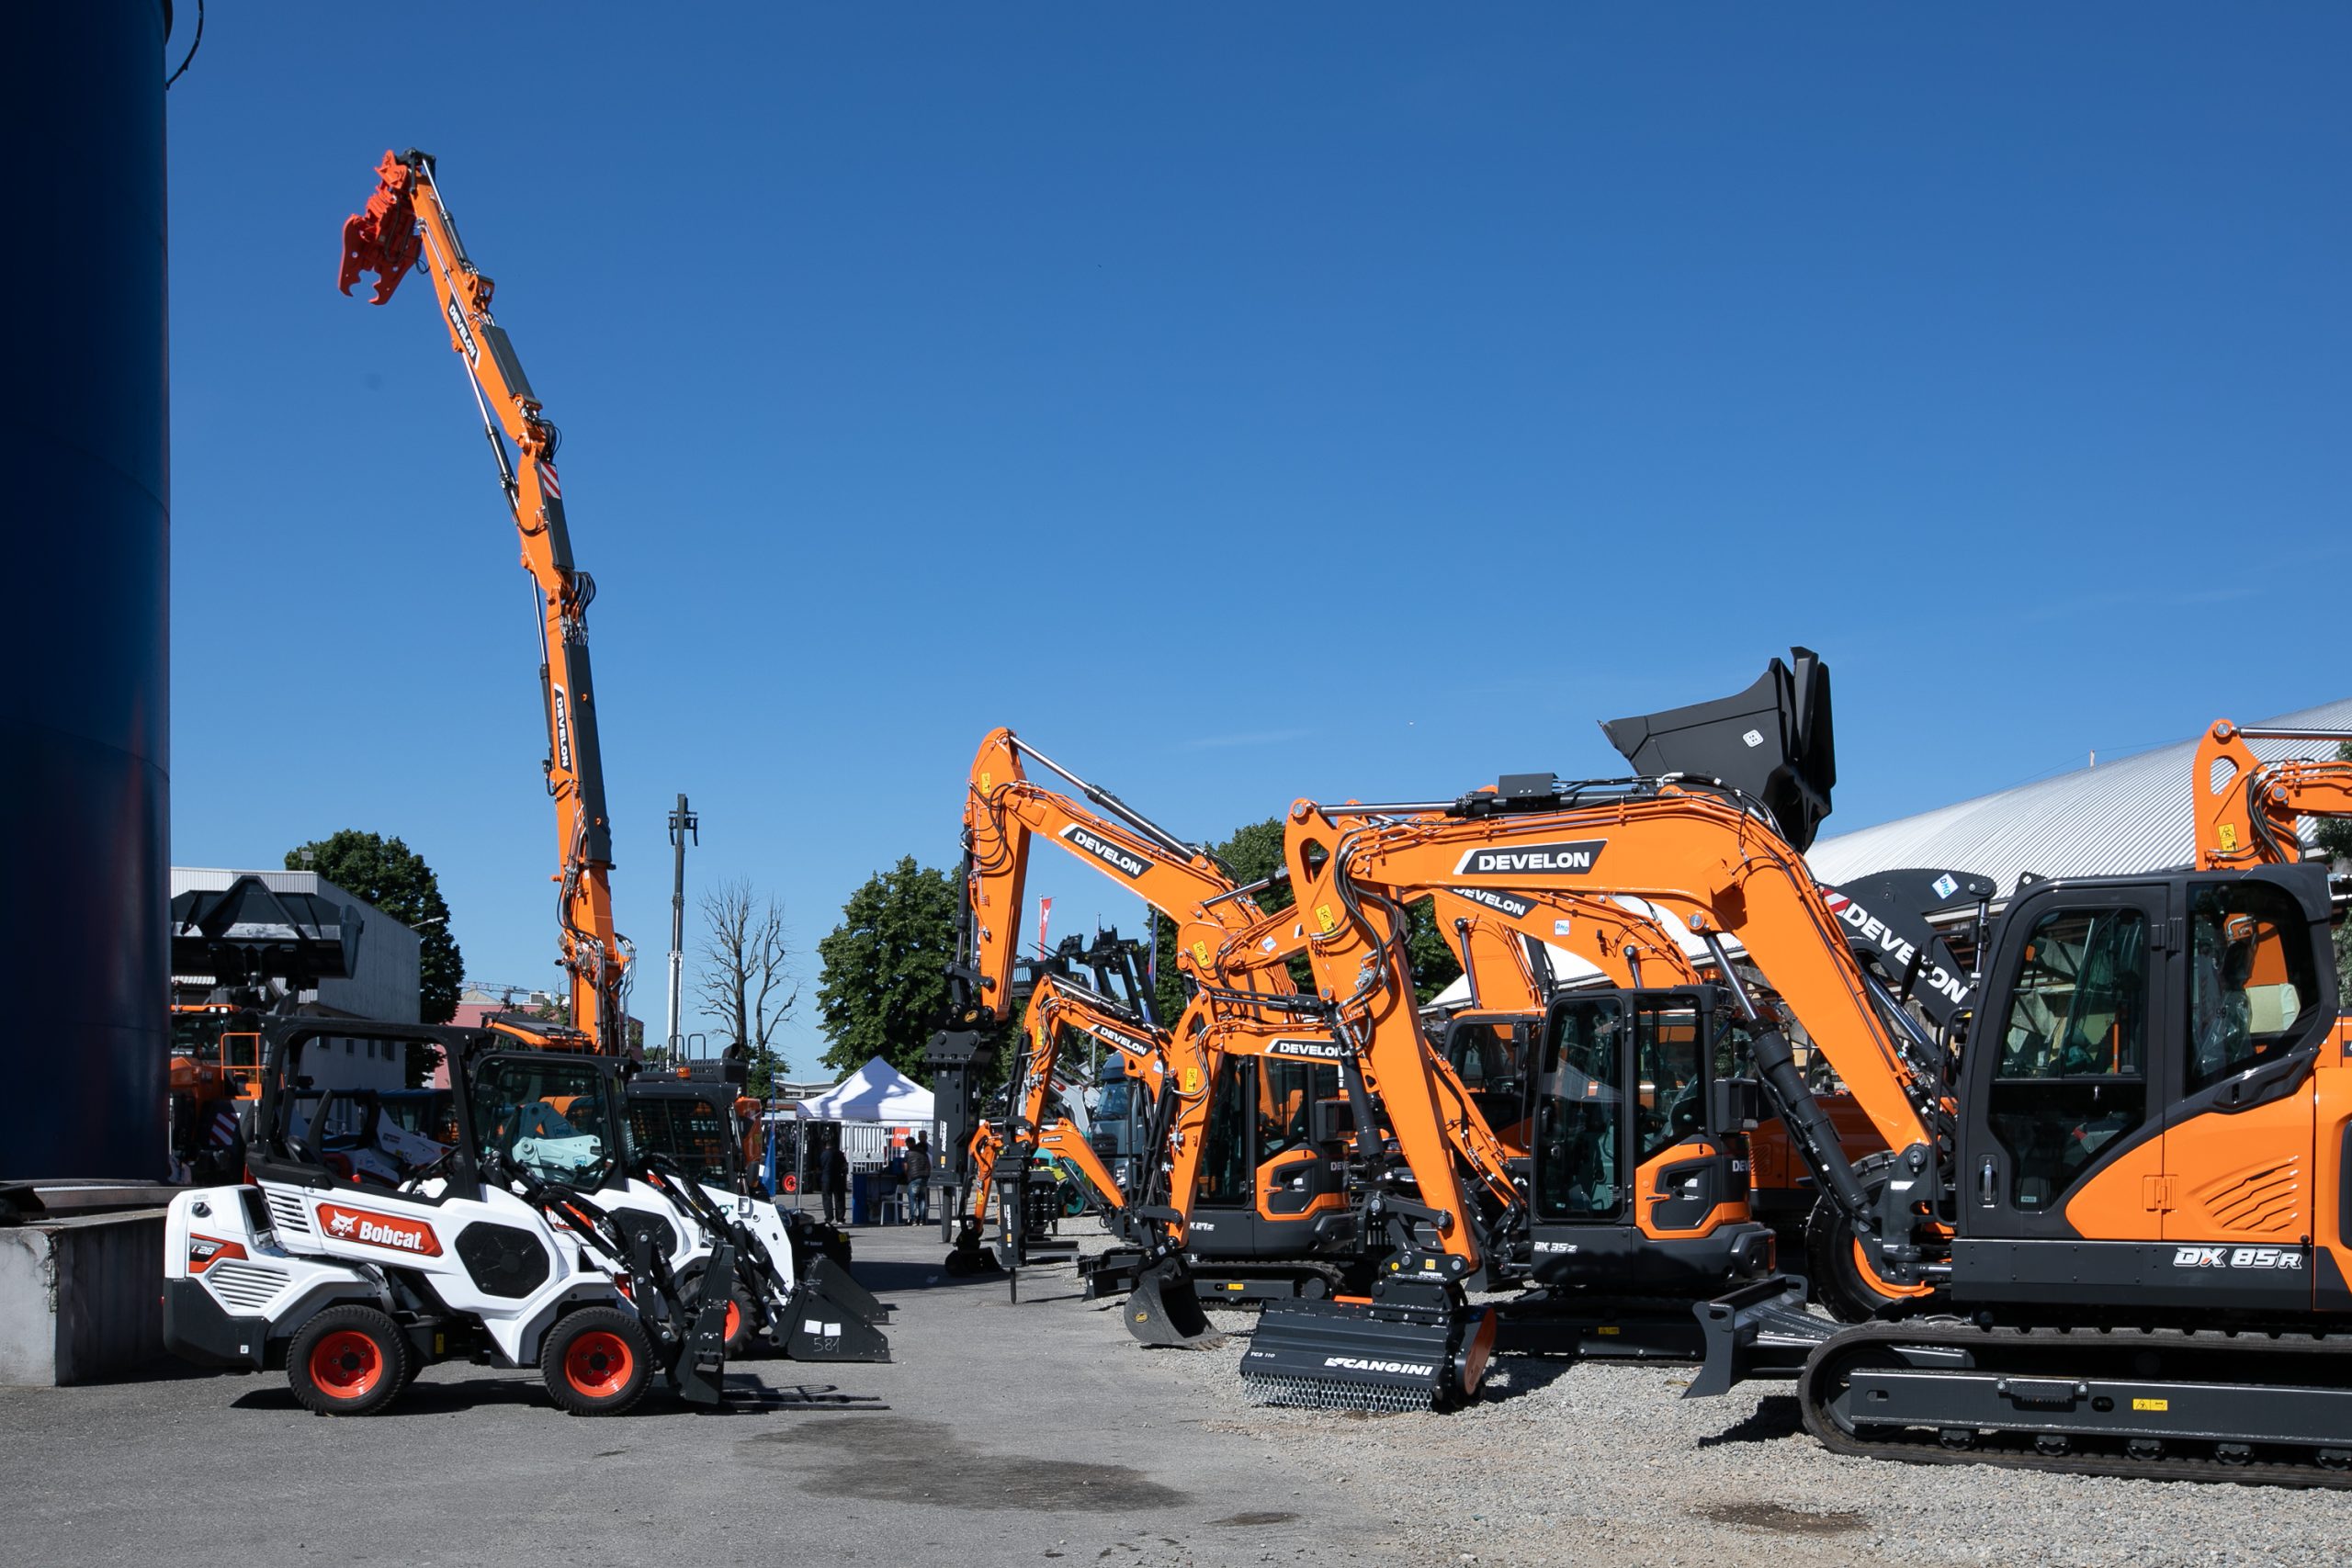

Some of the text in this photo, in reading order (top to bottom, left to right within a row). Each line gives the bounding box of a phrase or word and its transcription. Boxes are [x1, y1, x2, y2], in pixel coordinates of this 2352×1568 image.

[449, 304, 477, 357] DEVELON
[557, 697, 569, 767] DEVELON
[1074, 830, 1142, 875] DEVELON
[1478, 852, 1589, 871] DEVELON
[1100, 1027, 1148, 1056] DEVELON
[359, 1221, 422, 1250] Bobcat
[2173, 1247, 2302, 1269] DX 85R
[813, 1337, 840, 1353] 581
[1343, 1359, 1433, 1376] CANGINI
